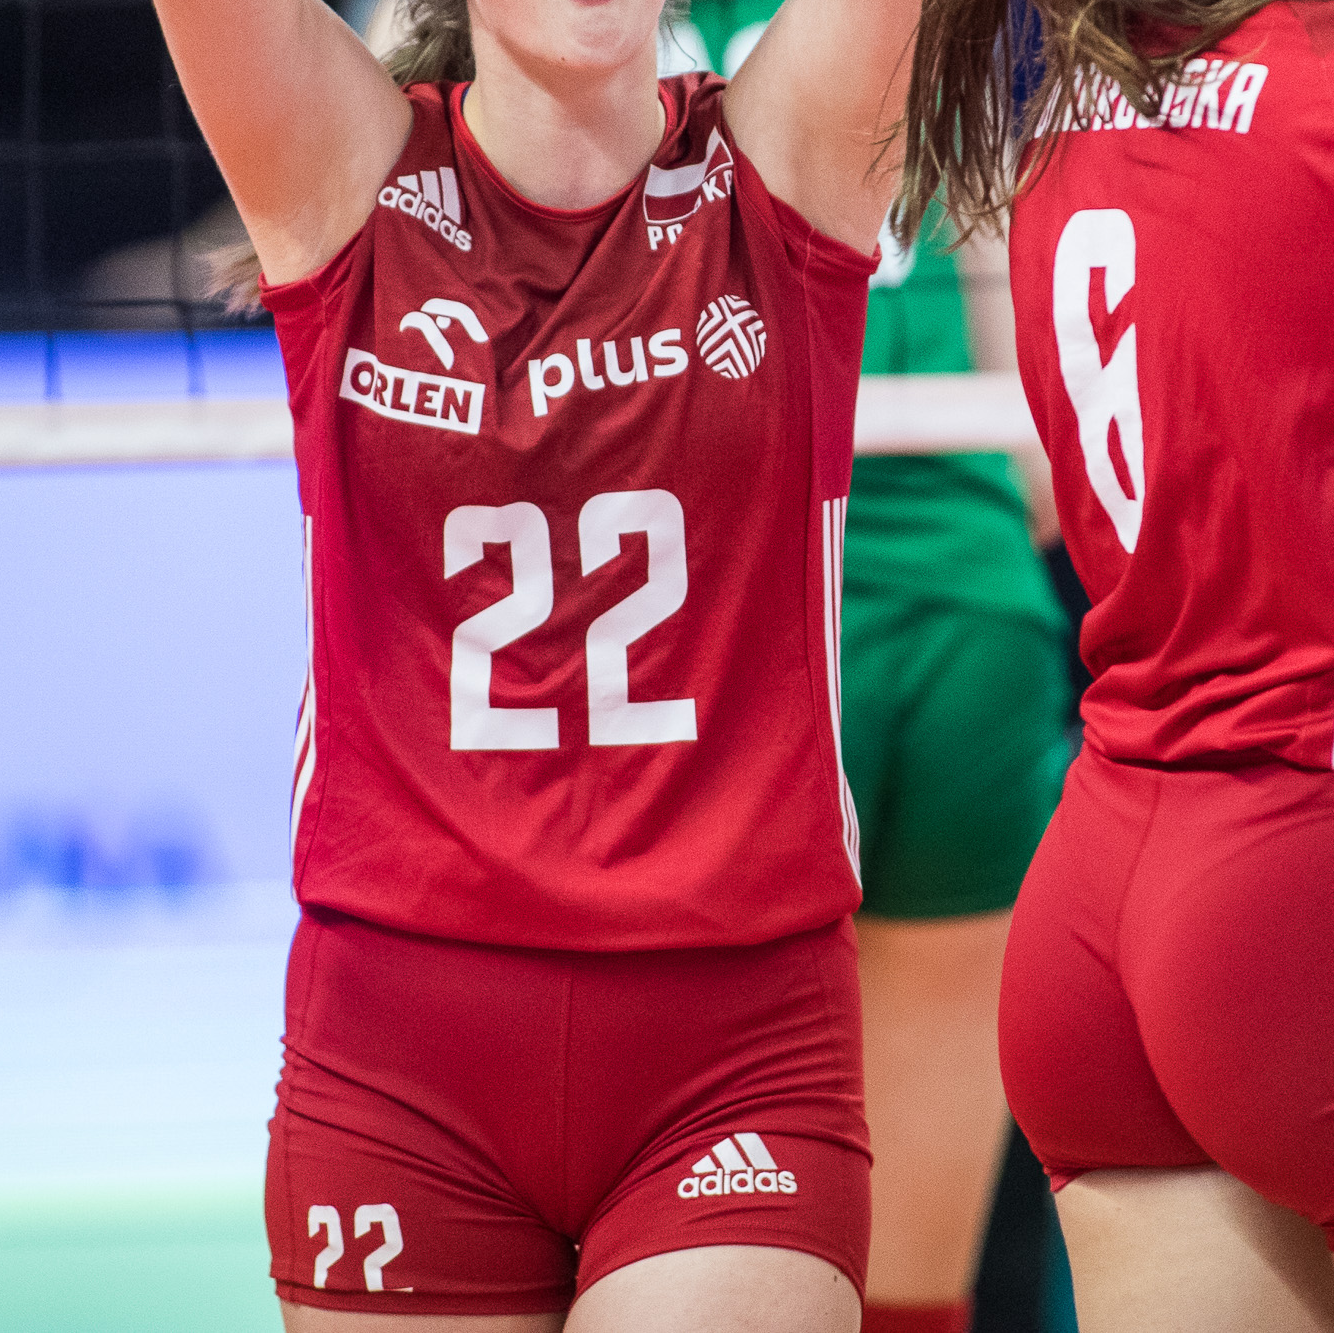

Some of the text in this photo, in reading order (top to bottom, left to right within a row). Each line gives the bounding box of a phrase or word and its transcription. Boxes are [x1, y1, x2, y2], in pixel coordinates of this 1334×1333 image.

[378, 186, 472, 252] adidas
[350, 361, 472, 423] ORLEN
[528, 328, 689, 417] plus
[1053, 208, 1145, 554] 6
[443, 488, 698, 750] 22
[677, 1167, 798, 1198] adidas
